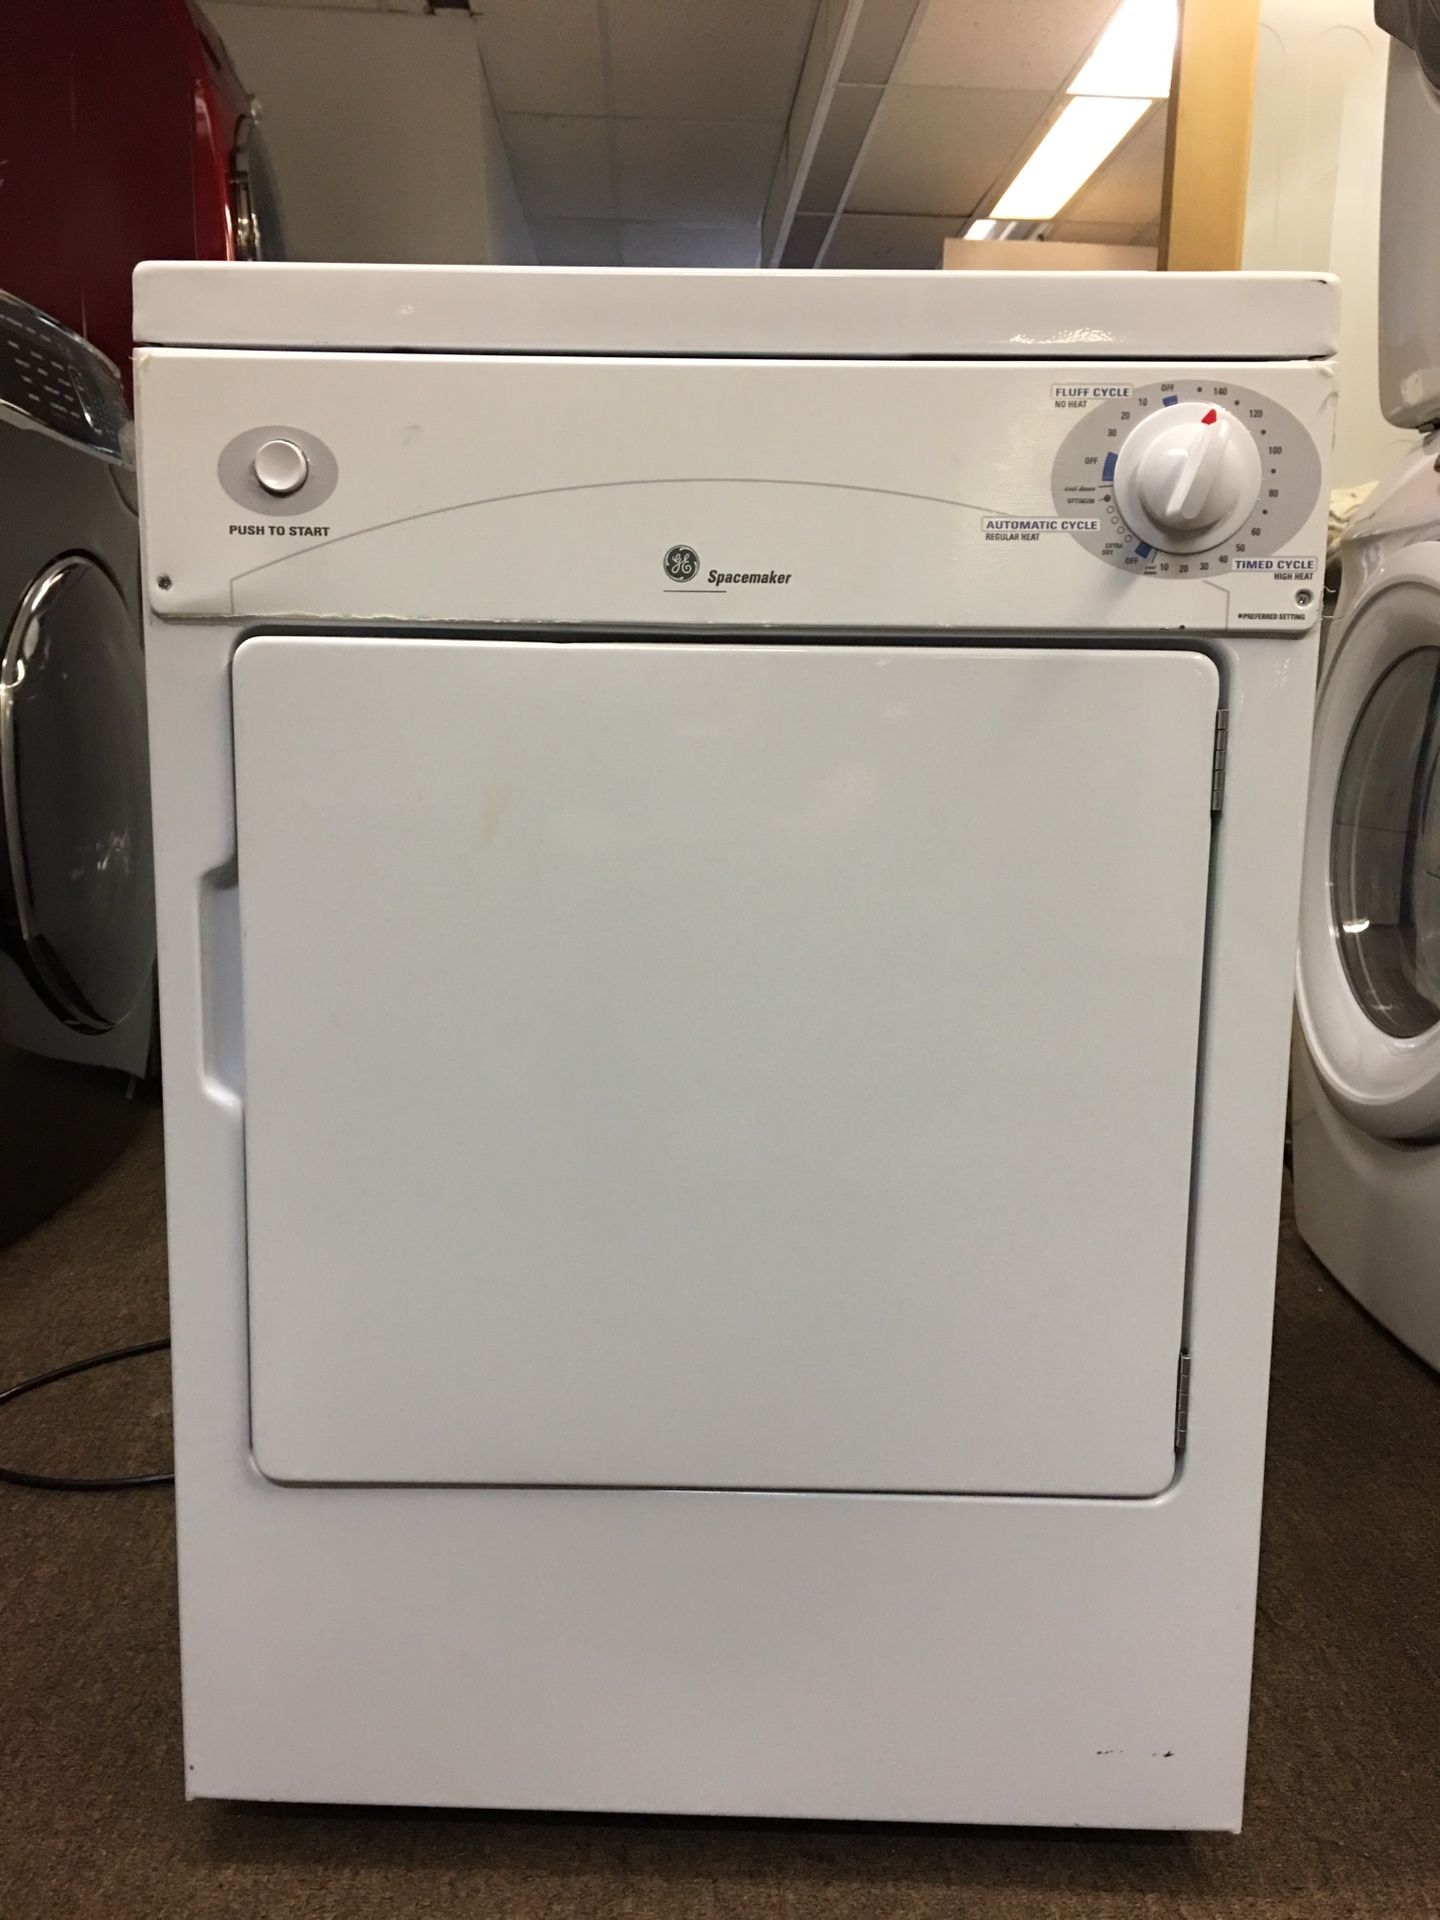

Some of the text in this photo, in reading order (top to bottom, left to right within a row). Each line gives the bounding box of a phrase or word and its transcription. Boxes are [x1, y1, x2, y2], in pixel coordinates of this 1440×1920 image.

[1055, 388, 1131, 397] FLUFF CYCLE
[1161, 384, 1174, 392] OFF
[1213, 387, 1228, 396] 140
[1055, 400, 1087, 408] NO HEAT
[1138, 398, 1147, 407] 10
[1121, 411, 1131, 420] 20
[1249, 409, 1263, 418] 120
[1107, 429, 1117, 437] 30
[1268, 446, 1282, 455] 100
[1085, 457, 1098, 465] OFF
[1268, 489, 1279, 498] 80
[986, 520, 1098, 530] AUTOMATIC CYCLE
[229, 525, 330, 536] PUSH TO START
[1251, 528, 1261, 536] 60
[985, 533, 1040, 541] REGULAR HEAT
[1235, 544, 1245, 553] 50
[1125, 557, 1138, 565] OFF
[1218, 555, 1229, 564] 40
[1160, 563, 1169, 571] 10
[1179, 565, 1189, 573] 20
[1199, 563, 1209, 571] 30
[1235, 560, 1314, 570] TIMED CYCLE
[708, 570, 792, 586] Spacemaker
[1274, 572, 1314, 581] HIGH HEAT
